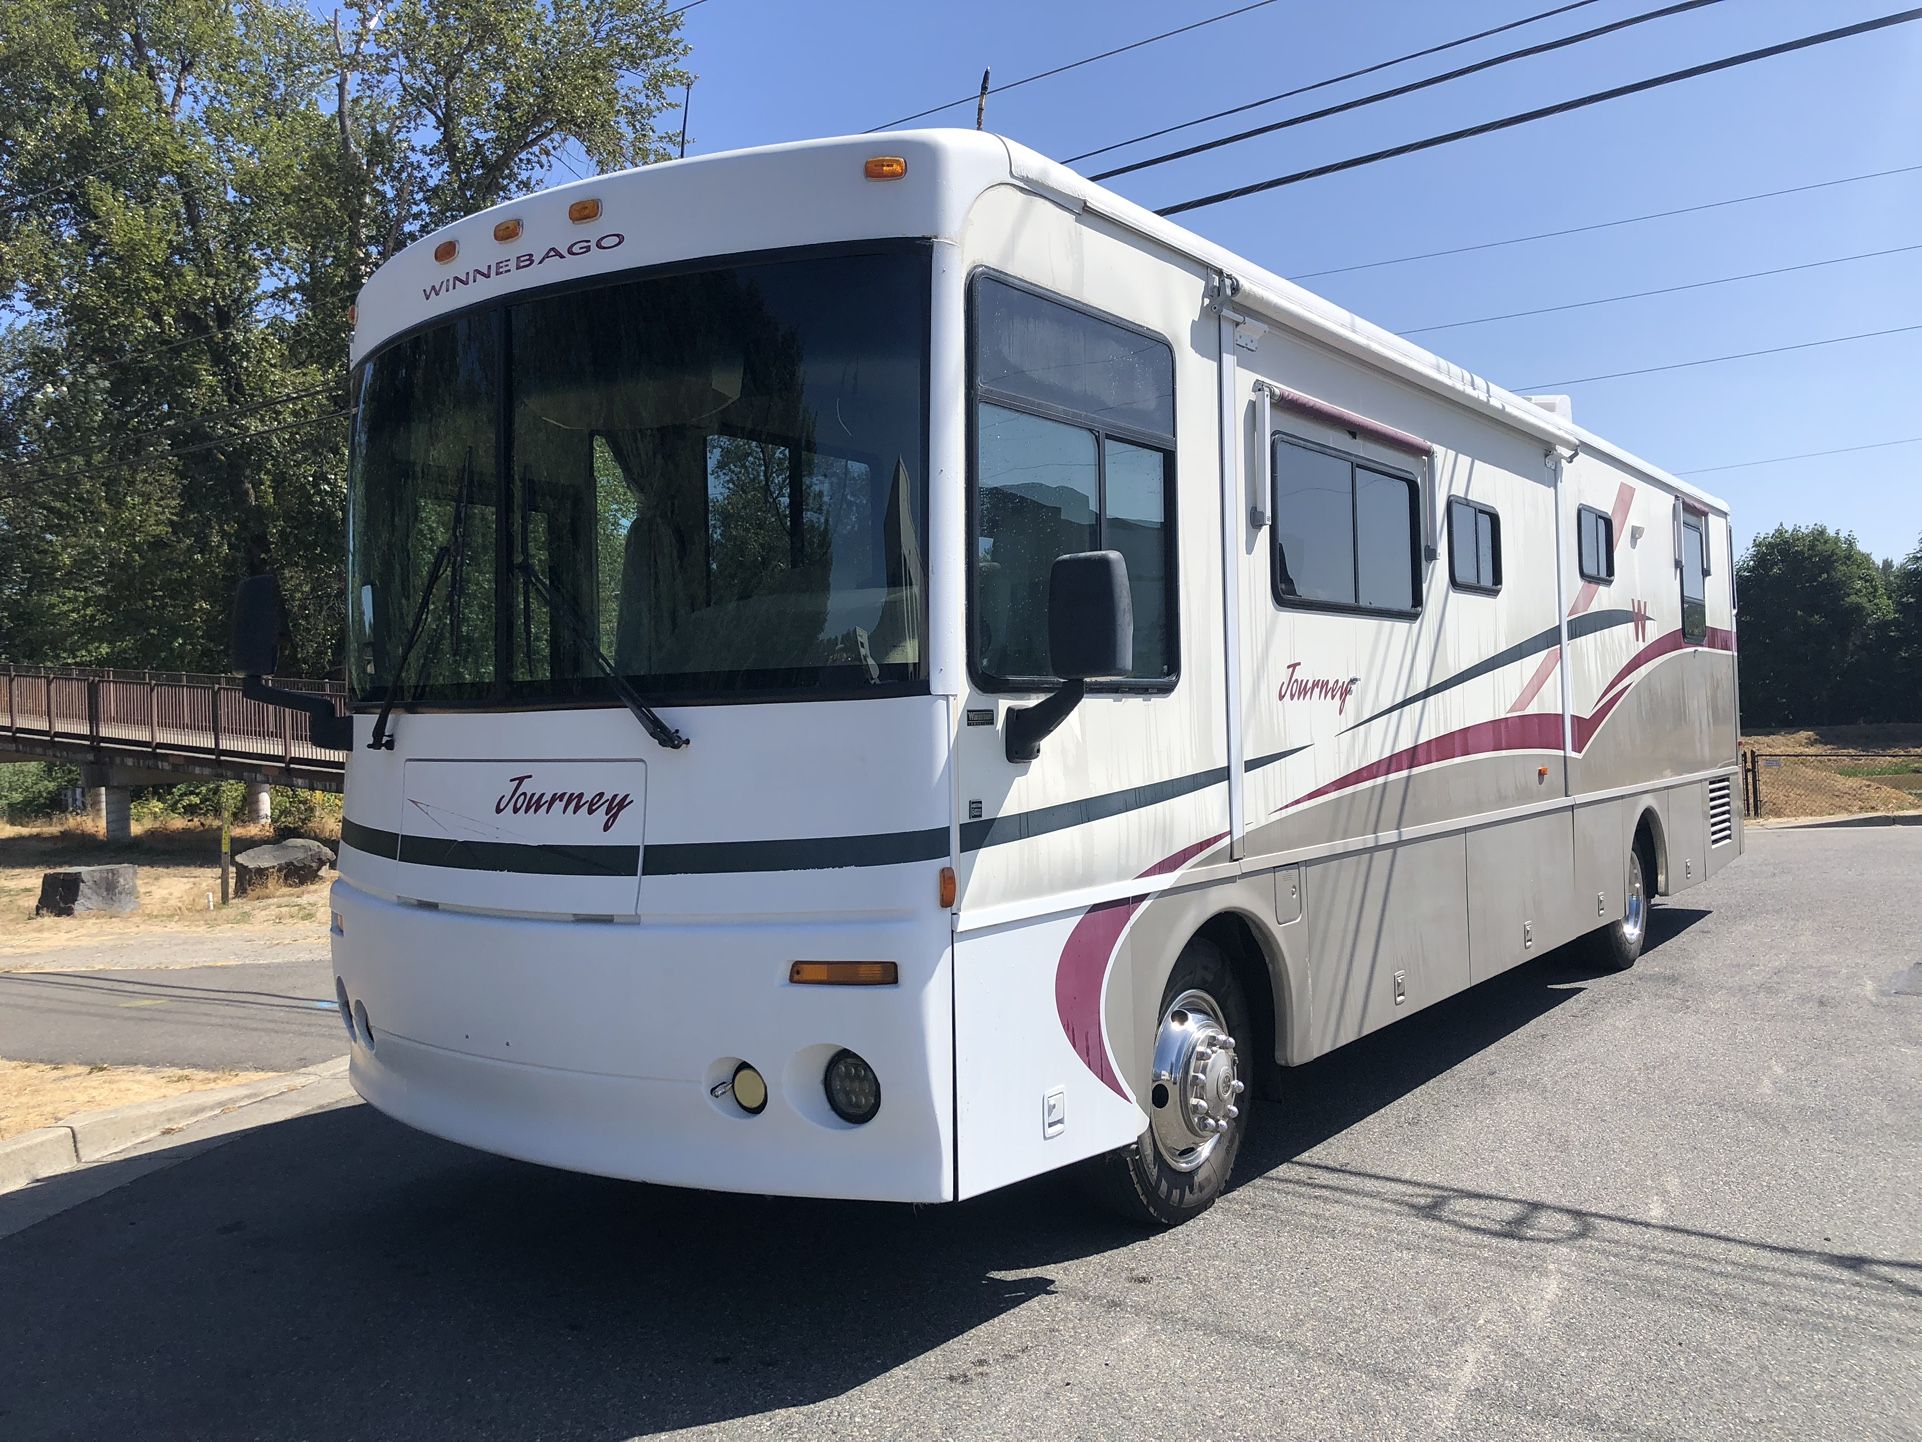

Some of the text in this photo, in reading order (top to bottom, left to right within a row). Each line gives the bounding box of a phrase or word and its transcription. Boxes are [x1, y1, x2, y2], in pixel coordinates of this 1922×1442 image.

[422, 233, 625, 301] WINNEBAGO
[1278, 661, 1352, 716] Journey
[495, 774, 634, 832] Journey
